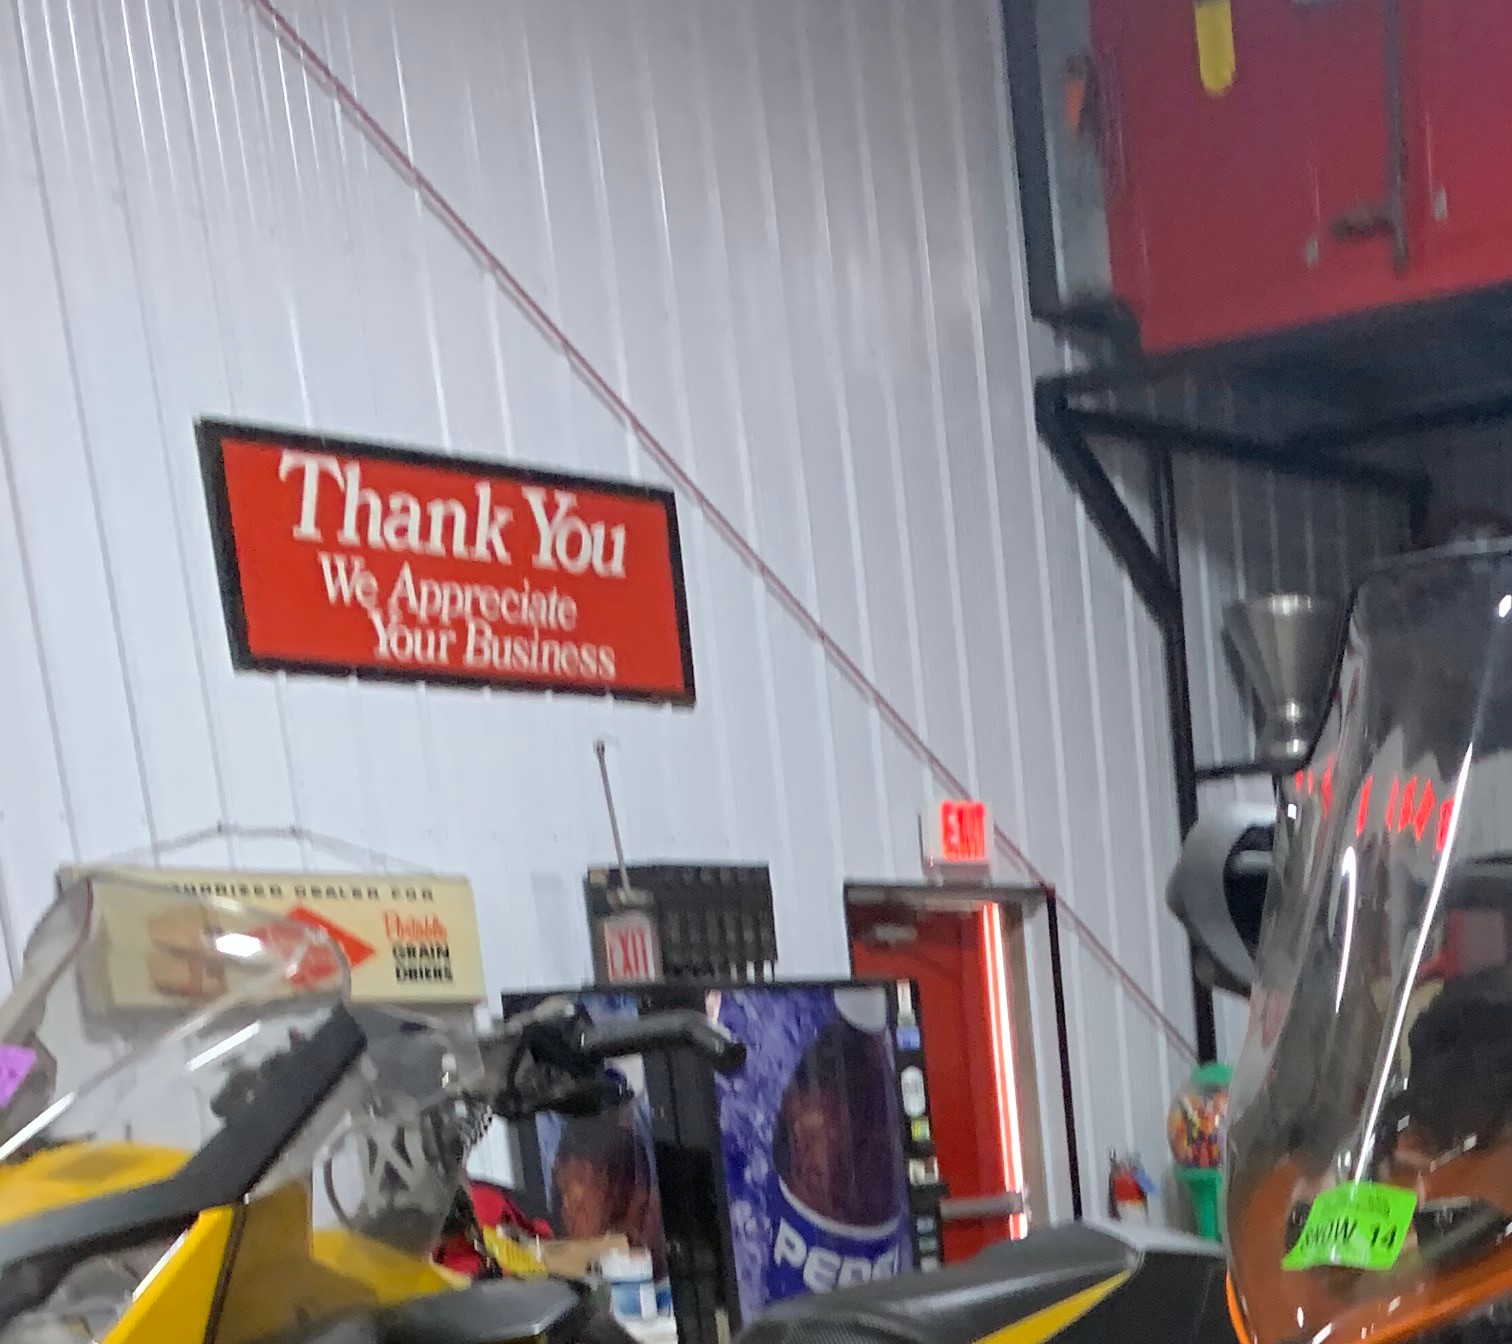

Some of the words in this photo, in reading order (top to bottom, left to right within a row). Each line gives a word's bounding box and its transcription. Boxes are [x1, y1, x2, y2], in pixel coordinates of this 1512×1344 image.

[278, 450, 512, 565] Thank
[523, 485, 627, 578] You
[318, 551, 379, 610] We
[388, 561, 578, 633] Appreciate
[370, 608, 457, 664] Your
[463, 619, 616, 681] Business
[941, 800, 985, 861] EXIT
[392, 943, 450, 960] GRAIN
[607, 926, 650, 978] EXIT
